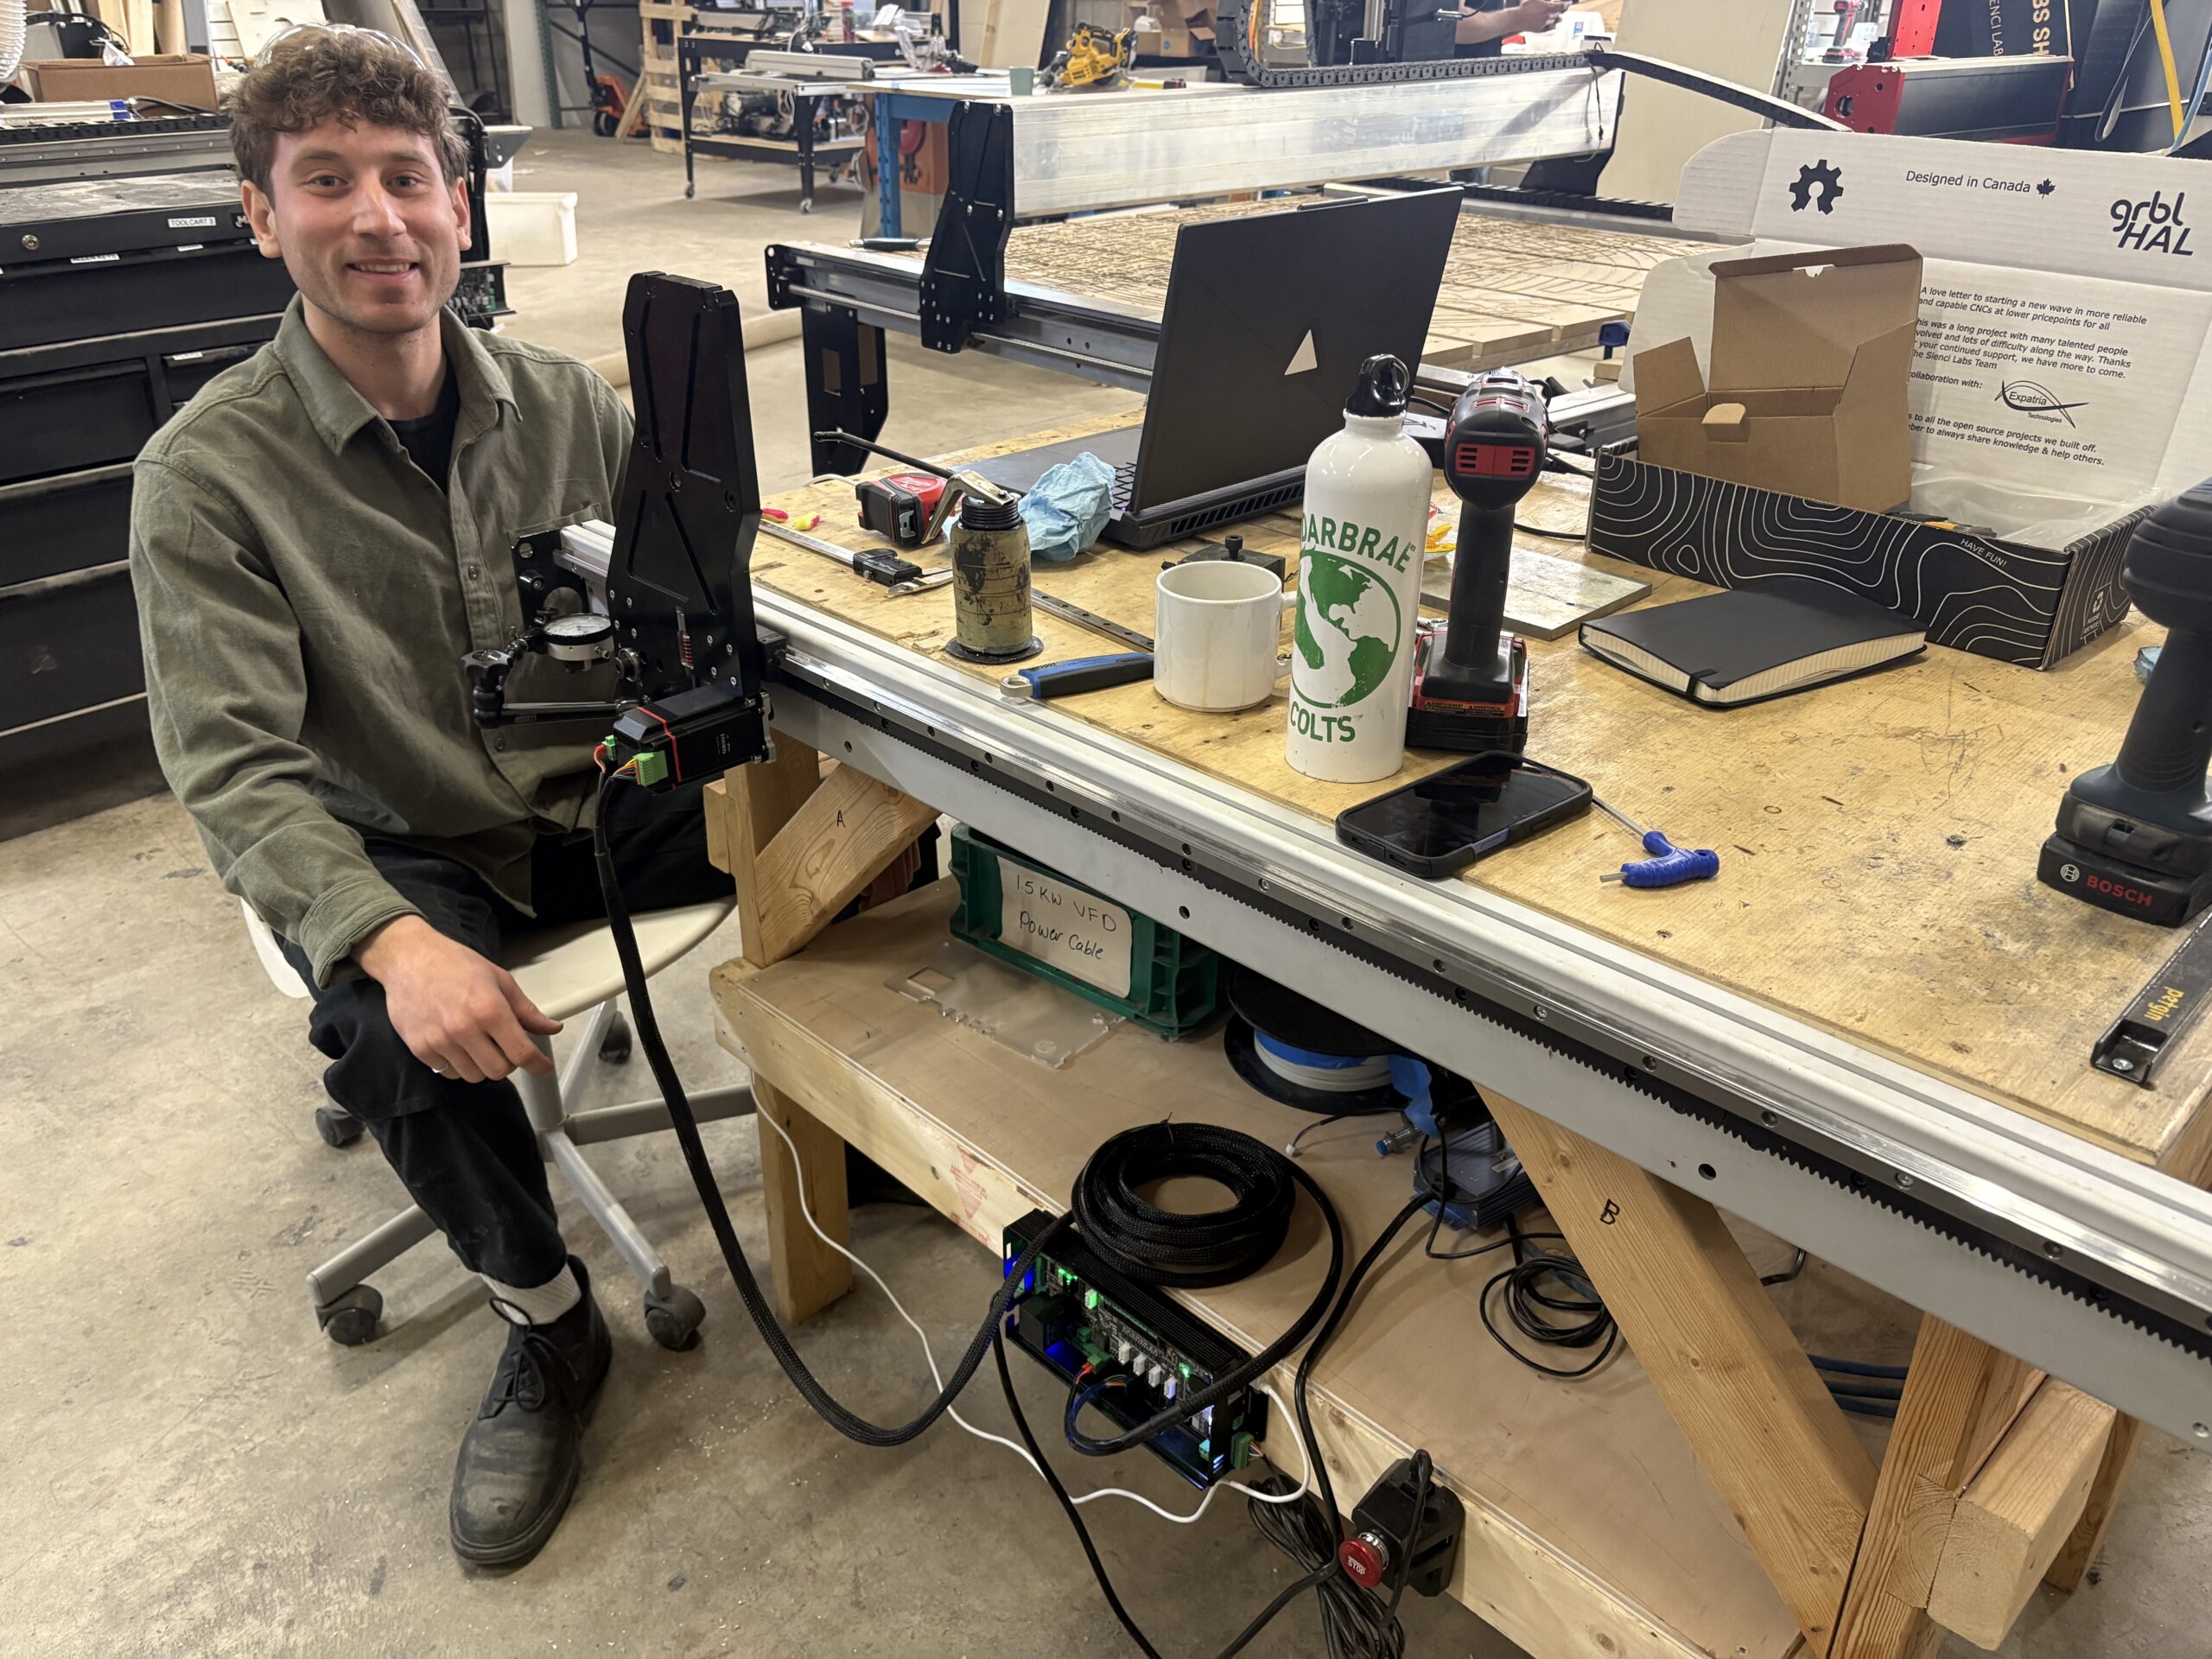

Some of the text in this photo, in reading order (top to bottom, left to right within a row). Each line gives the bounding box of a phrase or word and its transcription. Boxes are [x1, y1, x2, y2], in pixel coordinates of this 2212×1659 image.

[1992, 32, 2004, 56] LAB
[1906, 170, 2031, 193] Designed in Canada
[2110, 190, 2185, 232] grbl
[2117, 222, 2194, 256] HAL
[1918, 297, 1934, 306] and
[1936, 300, 1967, 310] capable
[1970, 303, 1992, 314] CNCs
[2005, 308, 2031, 319] lower
[2031, 313, 2081, 327] pricepoints
[2083, 320, 2097, 328] for
[1929, 288, 1947, 297] love
[1948, 290, 1972, 300] letter
[1985, 296, 2018, 308] starting
[2050, 304, 2073, 314] wave
[2075, 307, 2083, 315] in
[2086, 309, 2110, 319] more
[2112, 313, 2147, 324] reliable
[1916, 318, 1928, 327] his
[1956, 323, 1975, 334] long
[1976, 327, 2008, 338] project
[2010, 332, 2028, 341] with
[2031, 335, 2056, 346] many
[2057, 338, 2096, 352] talented
[2097, 345, 2129, 356] people
[1916, 330, 2132, 368] volved and lots of difficulty along the way. Thanks
[1919, 341, 1938, 350] your
[1939, 343, 1981, 356] continued
[1982, 351, 2018, 363] support,
[2036, 357, 2058, 368] have
[2060, 362, 2084, 372] more
[2086, 365, 2096, 374] to
[2098, 368, 2126, 379] come.
[1925, 351, 1951, 362] Sienci
[1953, 355, 1972, 365] Labs
[1975, 359, 1998, 370] Team
[1910, 371, 1983, 389] ollaboration with:
[2009, 391, 2047, 405] Expatria
[2027, 412, 2063, 423] Technologies
[1915, 413, 1923, 422] to
[1937, 417, 1951, 427] the
[1953, 421, 1974, 430] open
[1976, 425, 2005, 436] source
[2006, 430, 2043, 443] projects
[2044, 437, 2057, 446] we
[2060, 439, 2081, 449] built
[2082, 444, 2097, 454] off.
[1936, 429, 1965, 441] always
[1967, 434, 1991, 444] share
[1993, 437, 2040, 454] knowledge
[2051, 448, 2071, 460] help
[2073, 454, 2105, 466] others.
[1961, 538, 2007, 568] HAVE FUN!
[1290, 701, 1356, 743] COLTS
[836, 810, 846, 828] A
[2086, 874, 2153, 906] BOSCH
[1073, 900, 1116, 931] VFD
[1020, 911, 1104, 960] Power Cable
[1599, 1198, 1620, 1225] B
[1348, 1559, 1366, 1575] STOP
